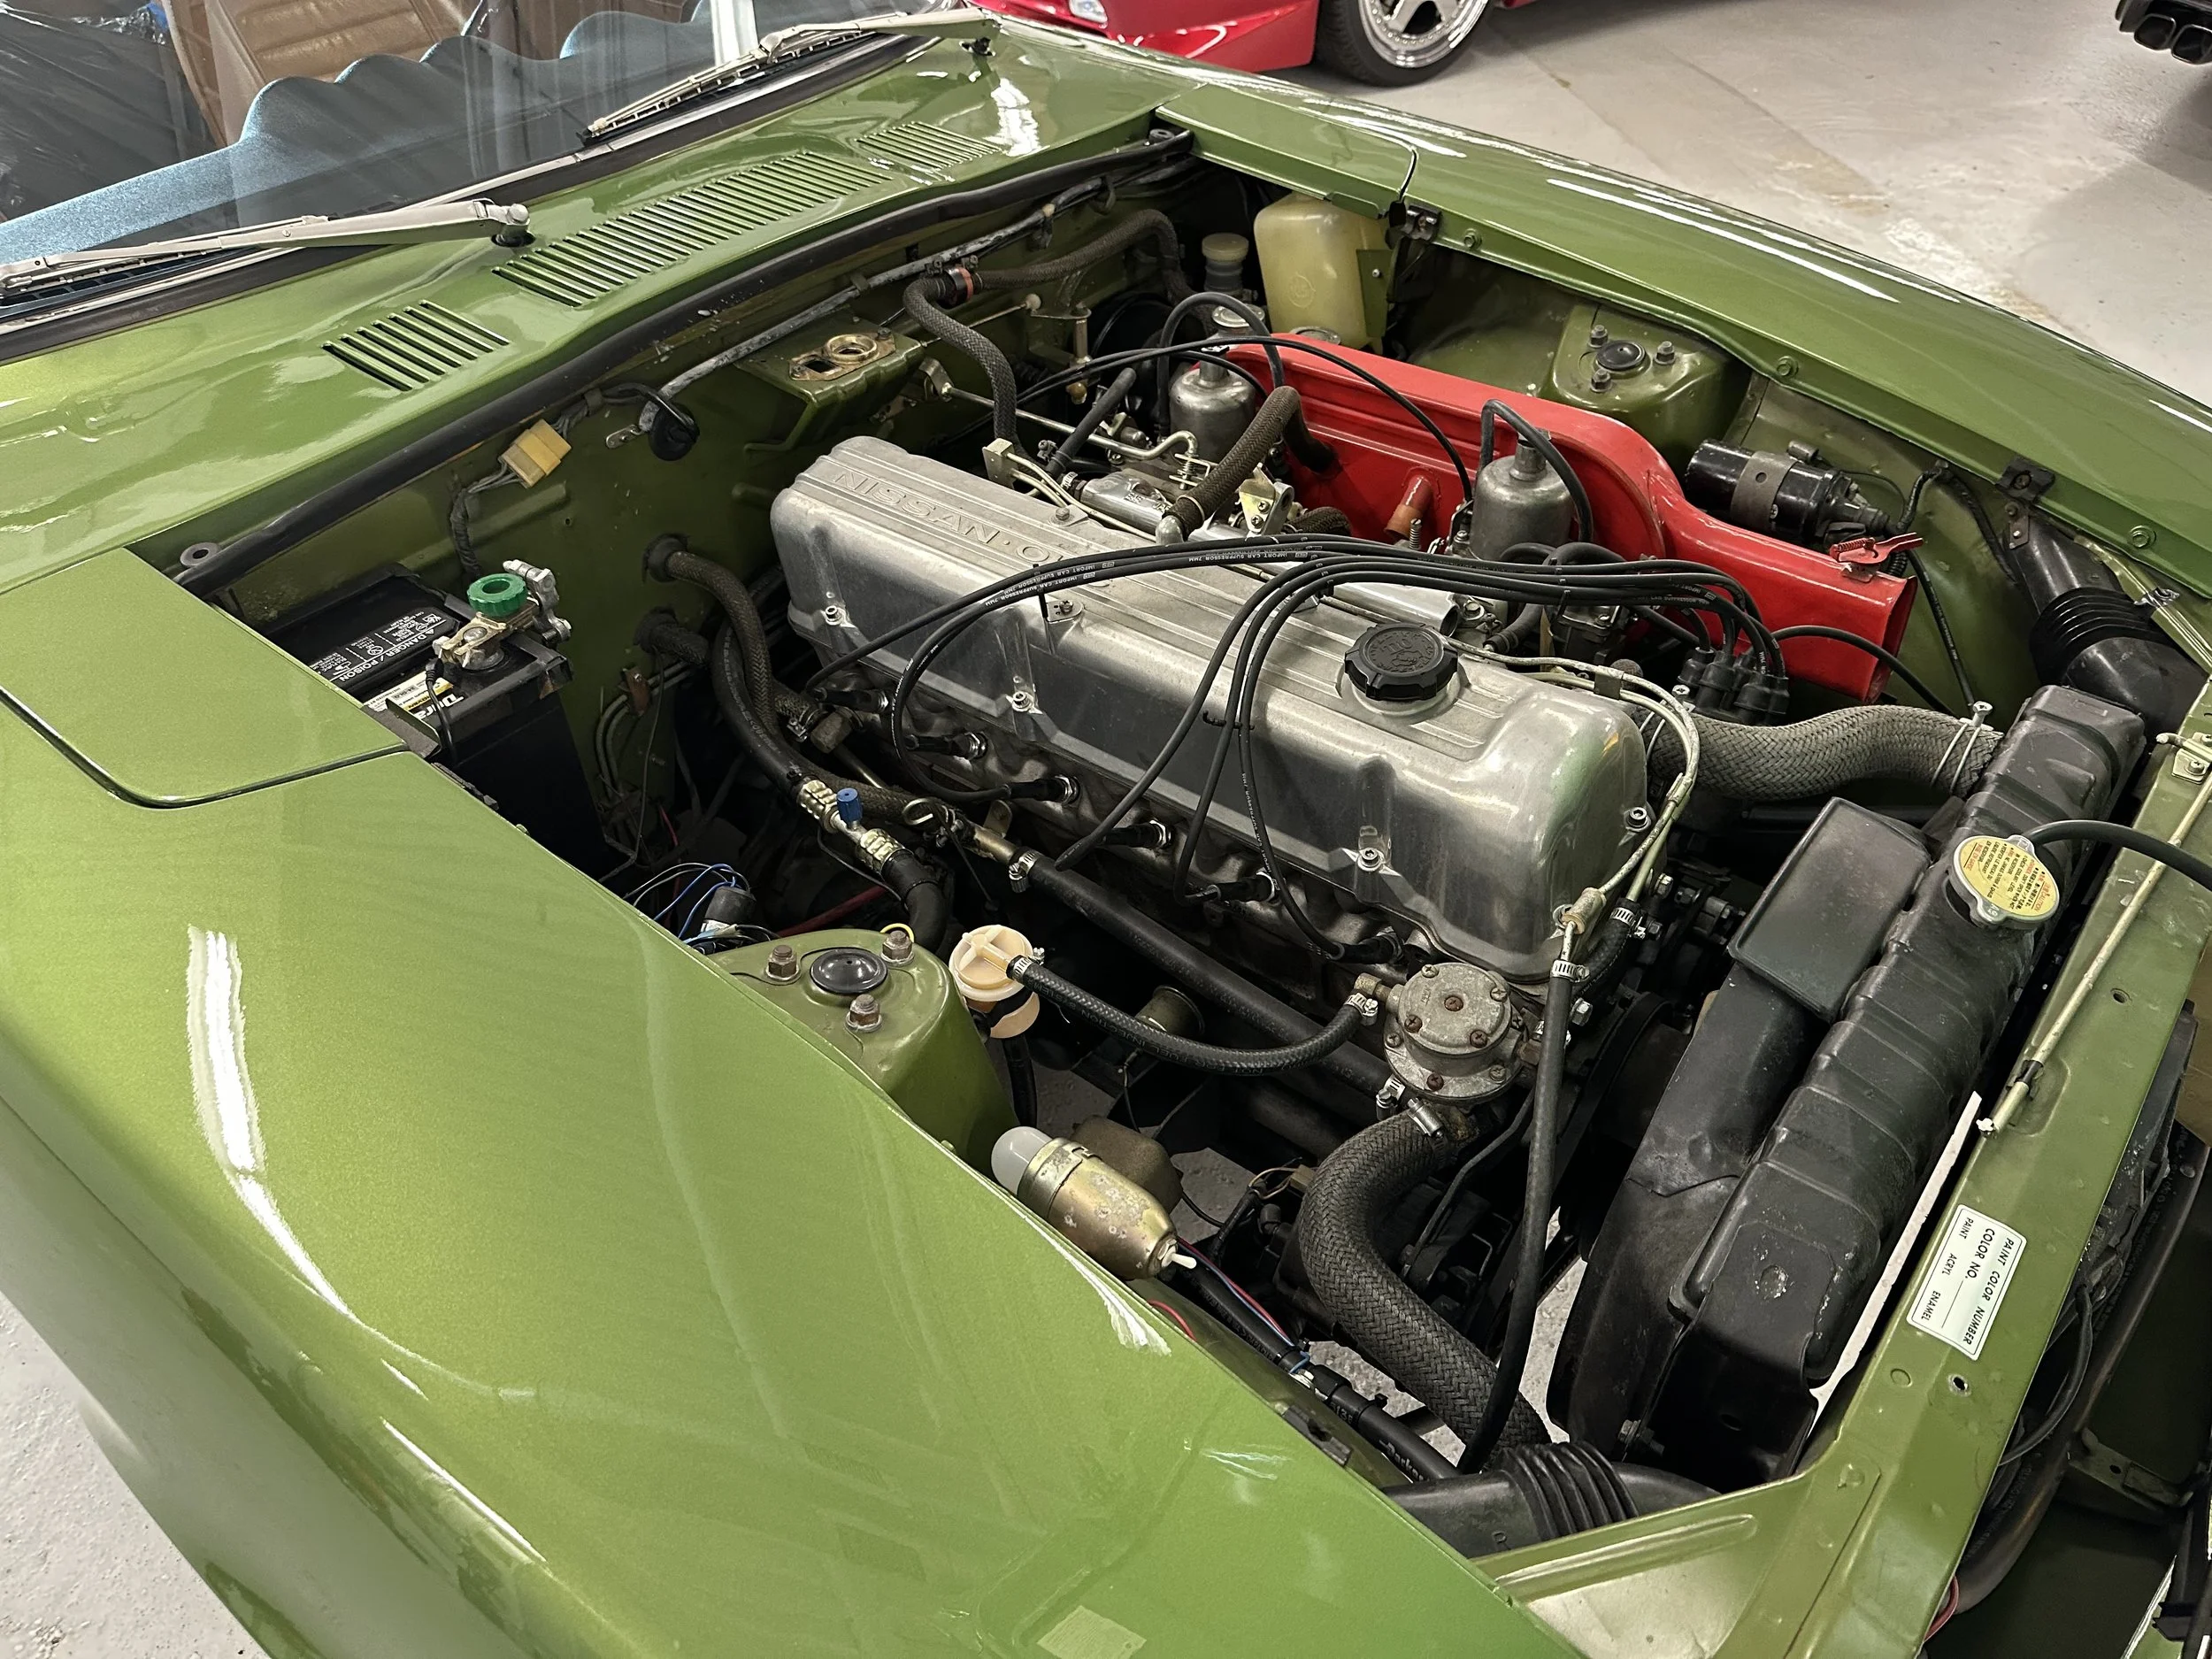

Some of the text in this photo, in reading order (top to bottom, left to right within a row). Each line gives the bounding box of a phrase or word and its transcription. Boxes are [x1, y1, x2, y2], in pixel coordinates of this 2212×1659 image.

[833, 471, 1001, 544] NISSAN
[1055, 575, 1077, 585] IMPORT
[1072, 564, 1095, 572] IMPORT
[1000, 585, 1037, 599] SUPPRESSOR
[385, 634, 426, 657] DANGER
[339, 660, 378, 682] POISON
[414, 694, 464, 719] Dura
[1079, 1007, 1146, 1048] INJECTION
[1964, 1228, 1995, 1279] COLOR NO.
[1921, 1217, 1974, 1321] PAINT ACRYL ENAMEL
[1962, 1237, 2015, 1345] PAINT COLOR NUMBER
